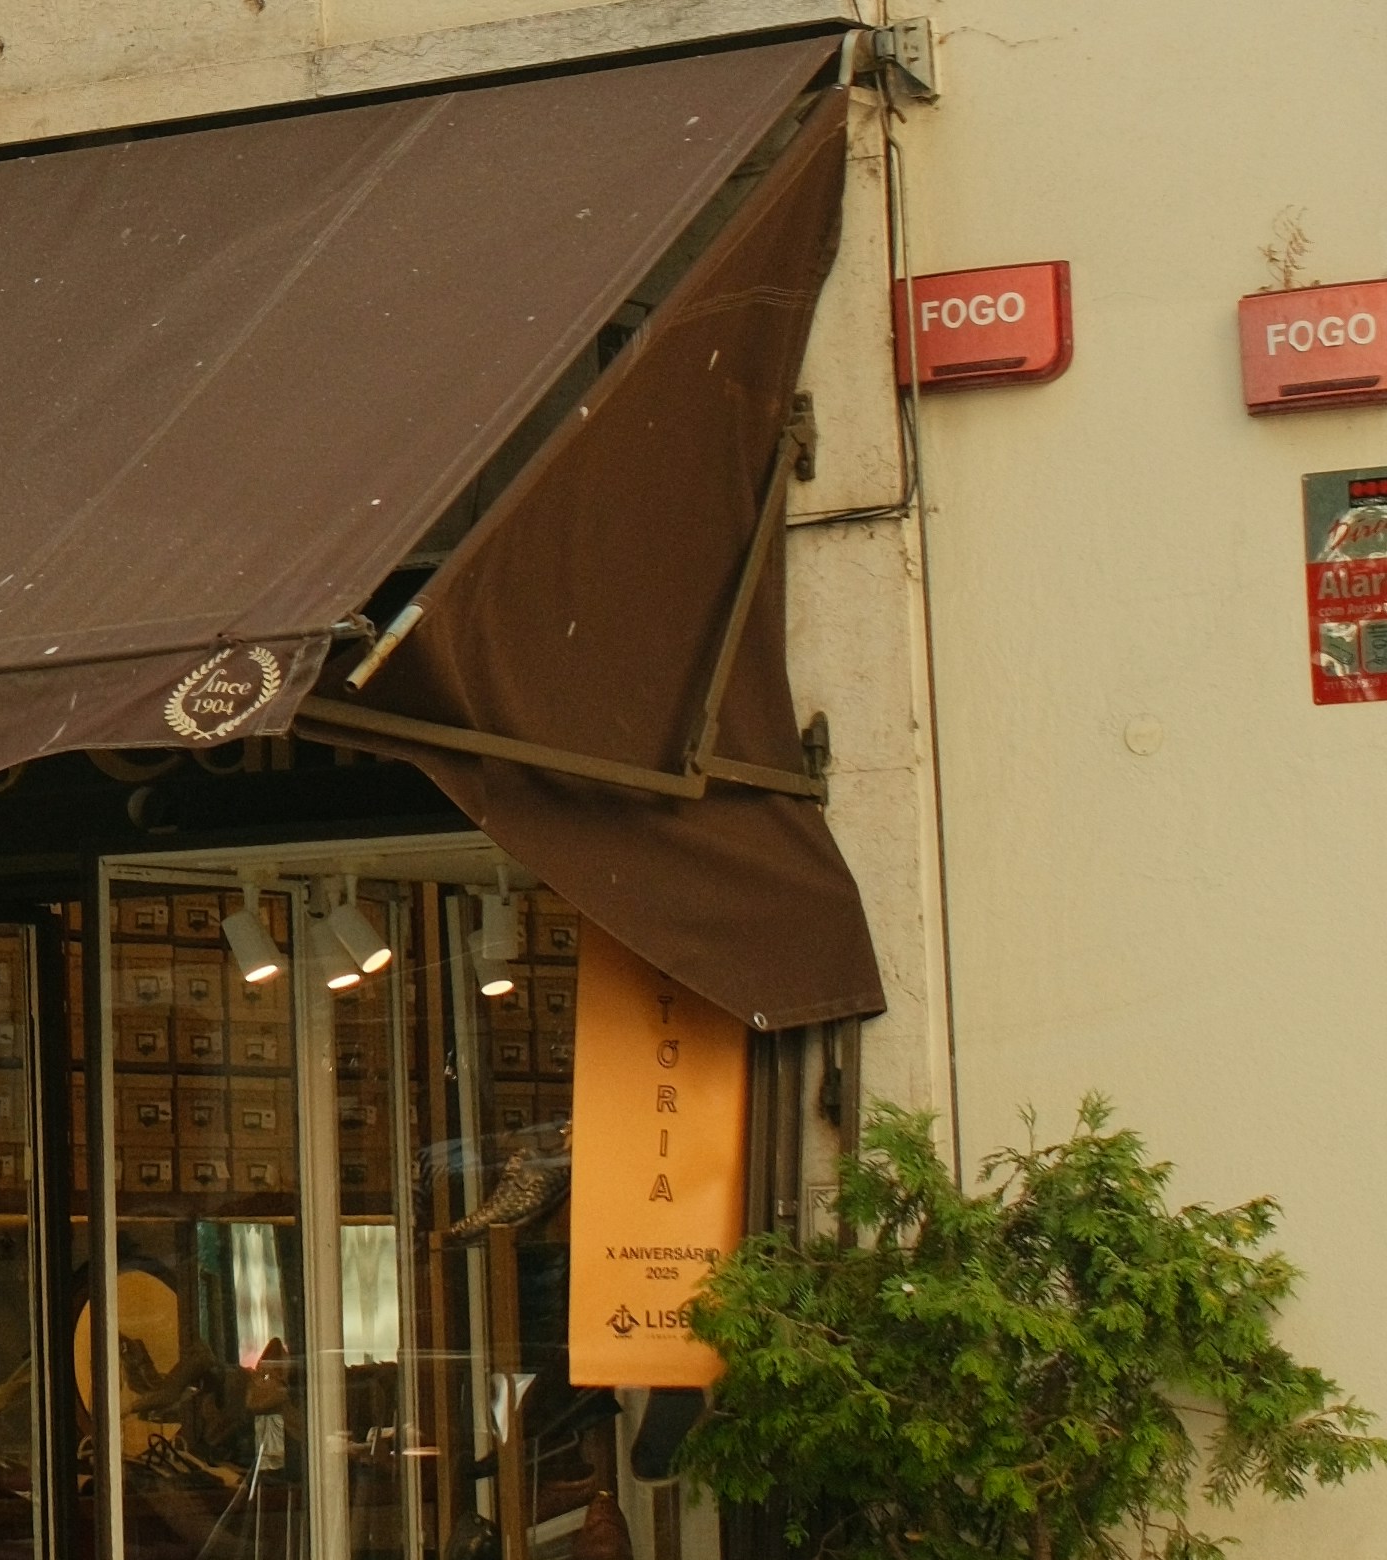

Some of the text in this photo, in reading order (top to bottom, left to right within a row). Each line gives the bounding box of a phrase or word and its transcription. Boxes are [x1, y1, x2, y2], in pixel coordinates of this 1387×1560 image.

[921, 291, 1026, 332] FOGO
[1266, 312, 1377, 356] FOGO
[1318, 569, 1387, 600] Alar
[189, 668, 252, 697] Since
[192, 698, 234, 716] 1904
[649, 971, 680, 1203] TÓRIA
[605, 1246, 616, 1260] X
[645, 1266, 680, 1280] 2025
[645, 1310, 691, 1329] LISB
